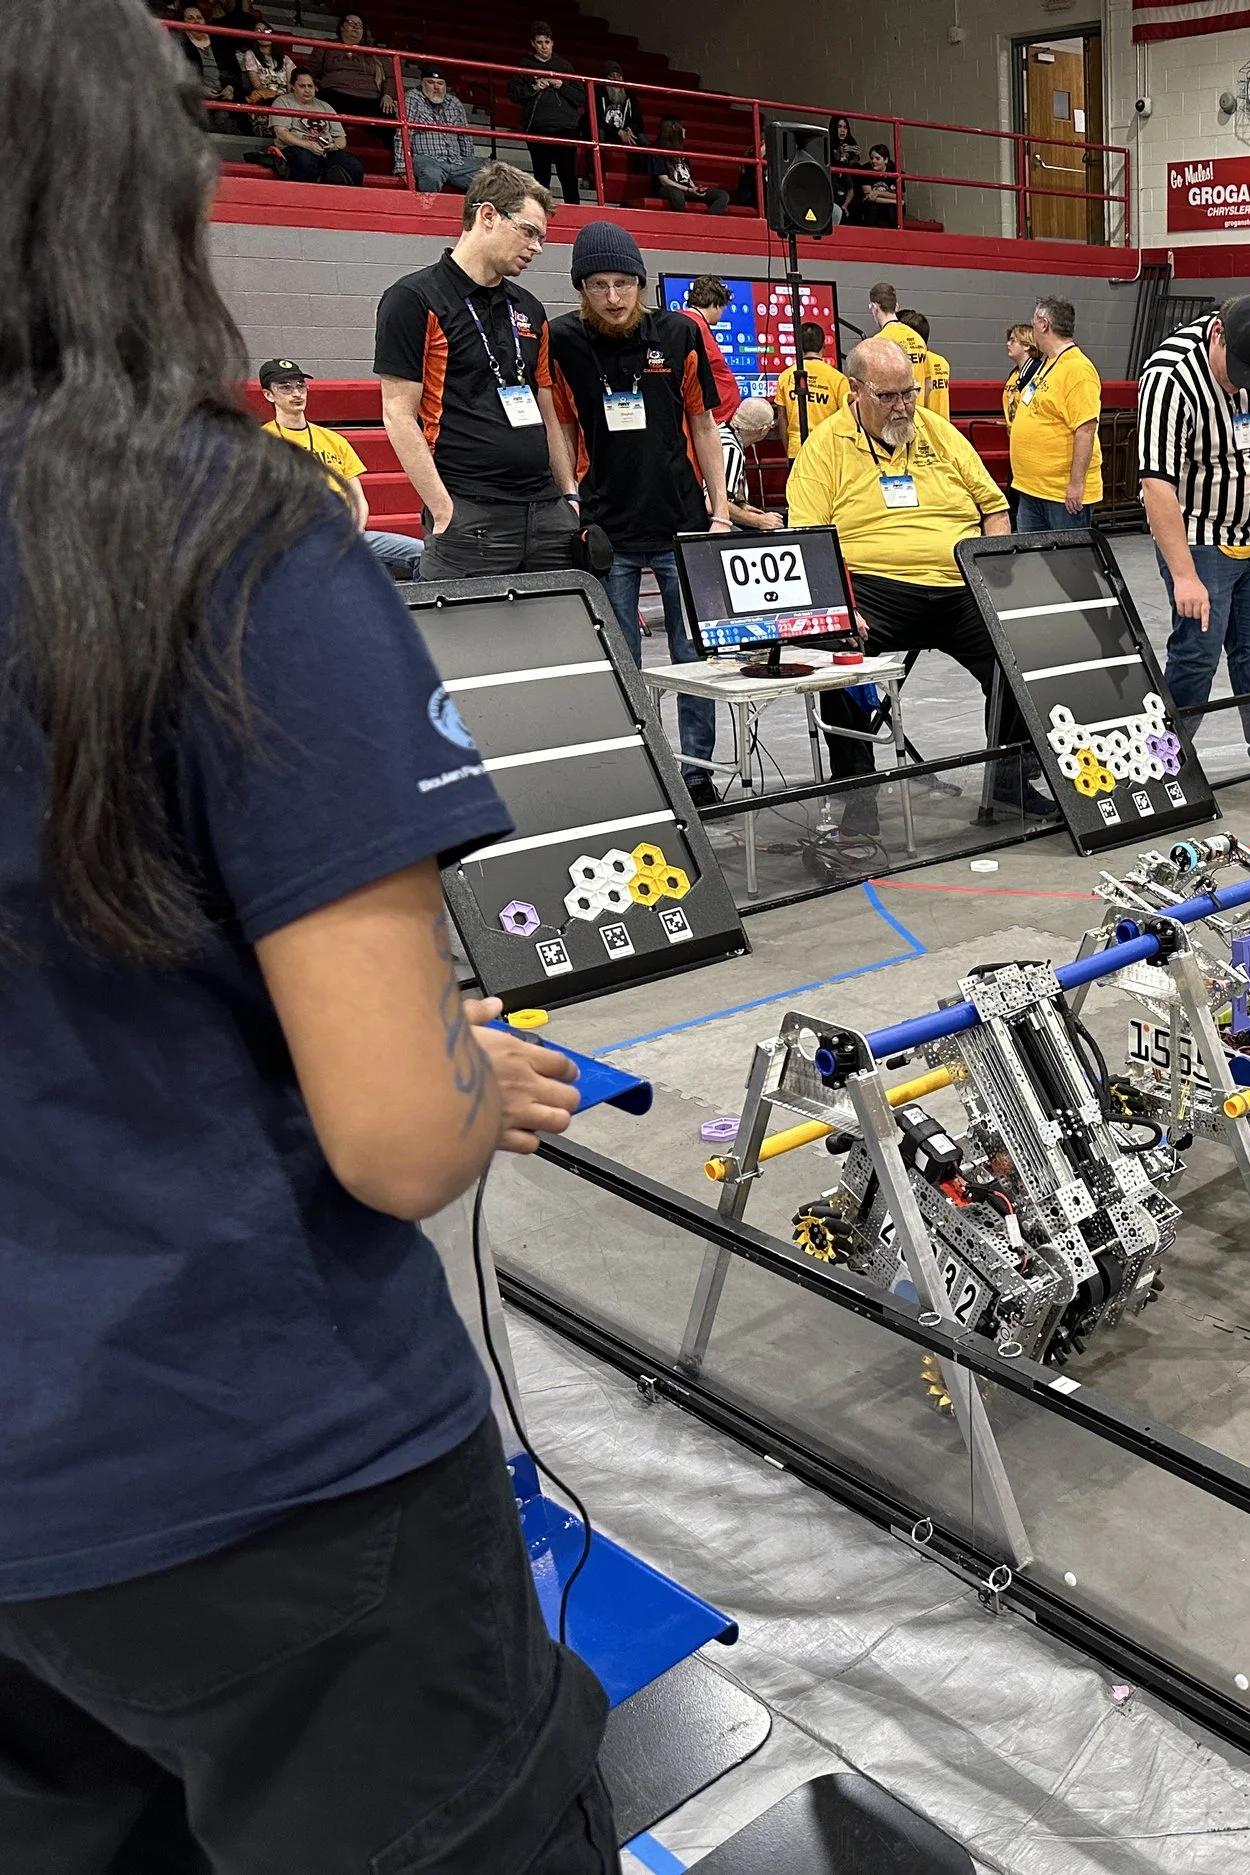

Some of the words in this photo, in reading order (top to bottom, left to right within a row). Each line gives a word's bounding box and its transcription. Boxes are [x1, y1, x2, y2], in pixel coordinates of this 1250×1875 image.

[1170, 170, 1183, 189] Go
[1185, 162, 1214, 186] Mules!
[1207, 205, 1250, 217] CHRYSLER
[789, 390, 830, 405] CEW
[729, 551, 802, 586] 0:02
[766, 624, 776, 634] 79
